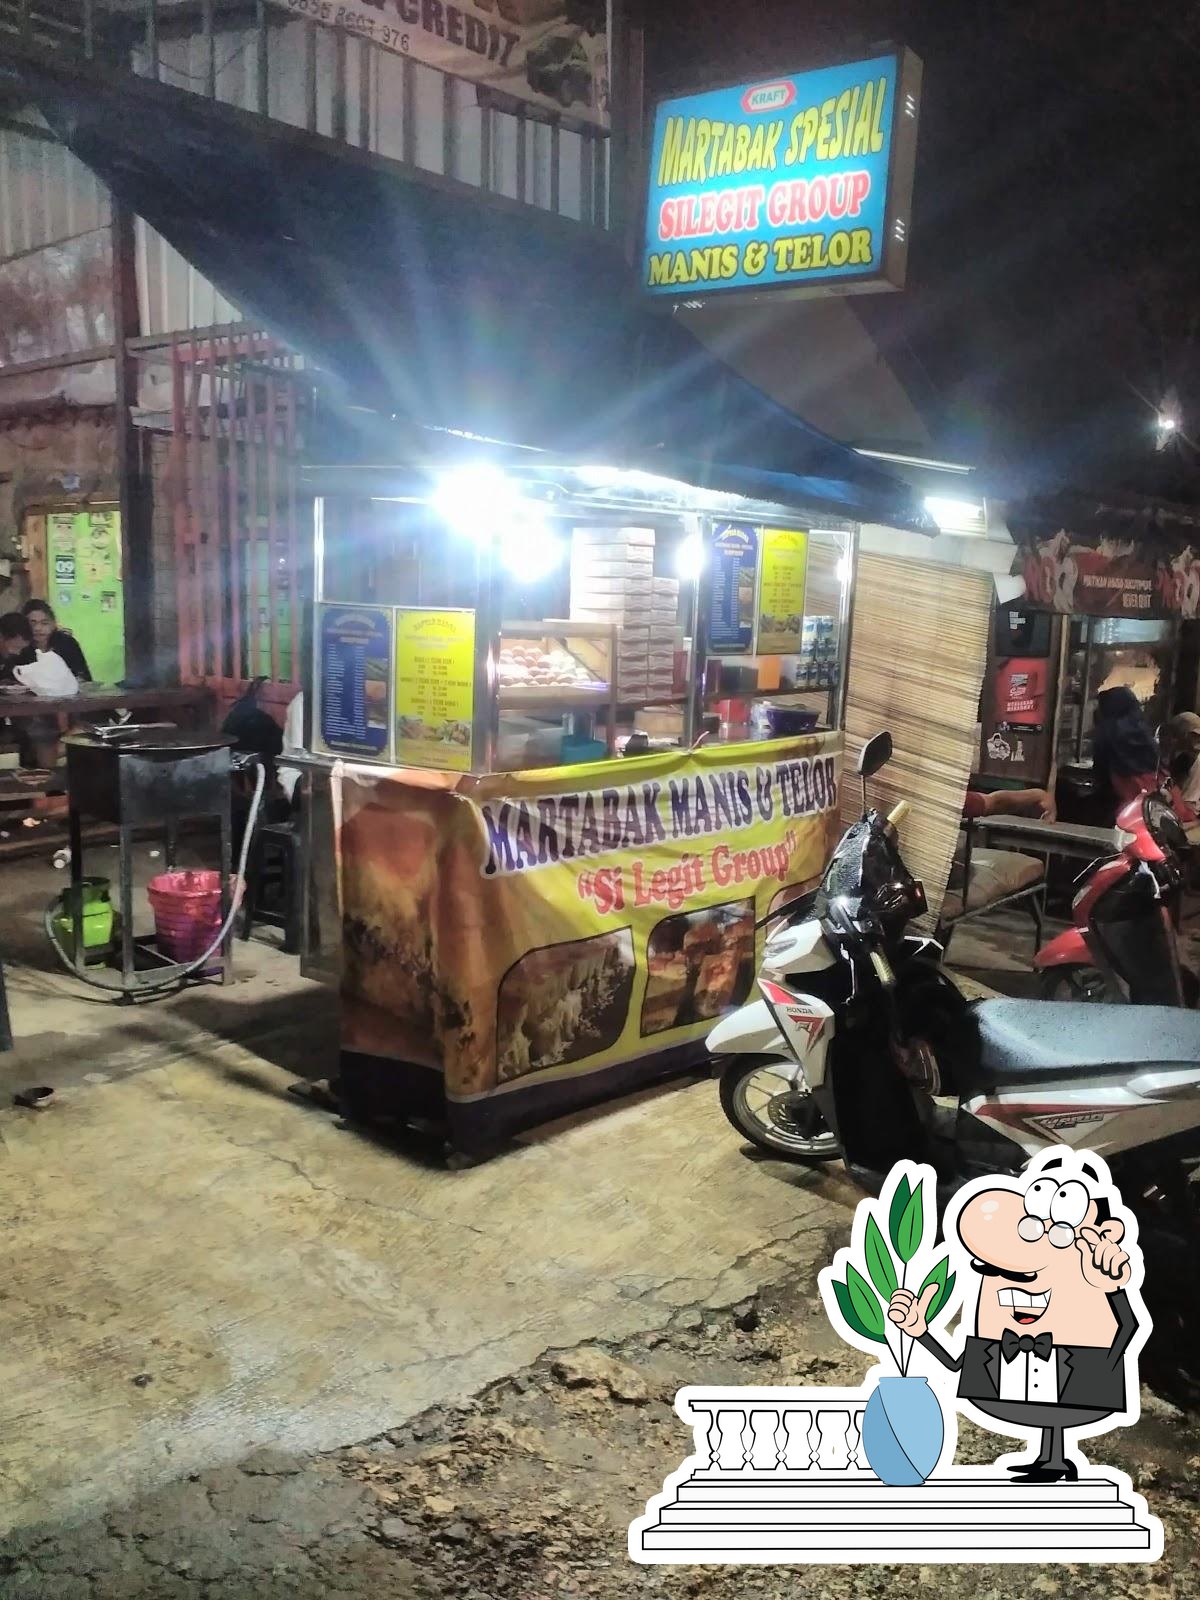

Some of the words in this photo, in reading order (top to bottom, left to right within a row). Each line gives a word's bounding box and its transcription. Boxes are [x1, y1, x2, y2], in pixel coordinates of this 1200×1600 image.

[382, 25, 410, 52] 976
[396, 0, 520, 66] CREDIT
[751, 88, 786, 105] KRAFT
[657, 116, 784, 187] MARTABAK
[784, 77, 887, 166] SPESIAL
[660, 186, 764, 240] SILEGIT
[768, 171, 870, 224] GROUP
[648, 244, 738, 286] MANIS
[743, 242, 768, 276] &
[773, 229, 872, 272] TELOR
[483, 780, 665, 875] MARTABAK
[669, 769, 753, 836] MANIS
[756, 767, 773, 821] &
[775, 756, 837, 816] TELOR
[632, 853, 706, 909] Legit
[785, 1006, 814, 1015] HONDA
